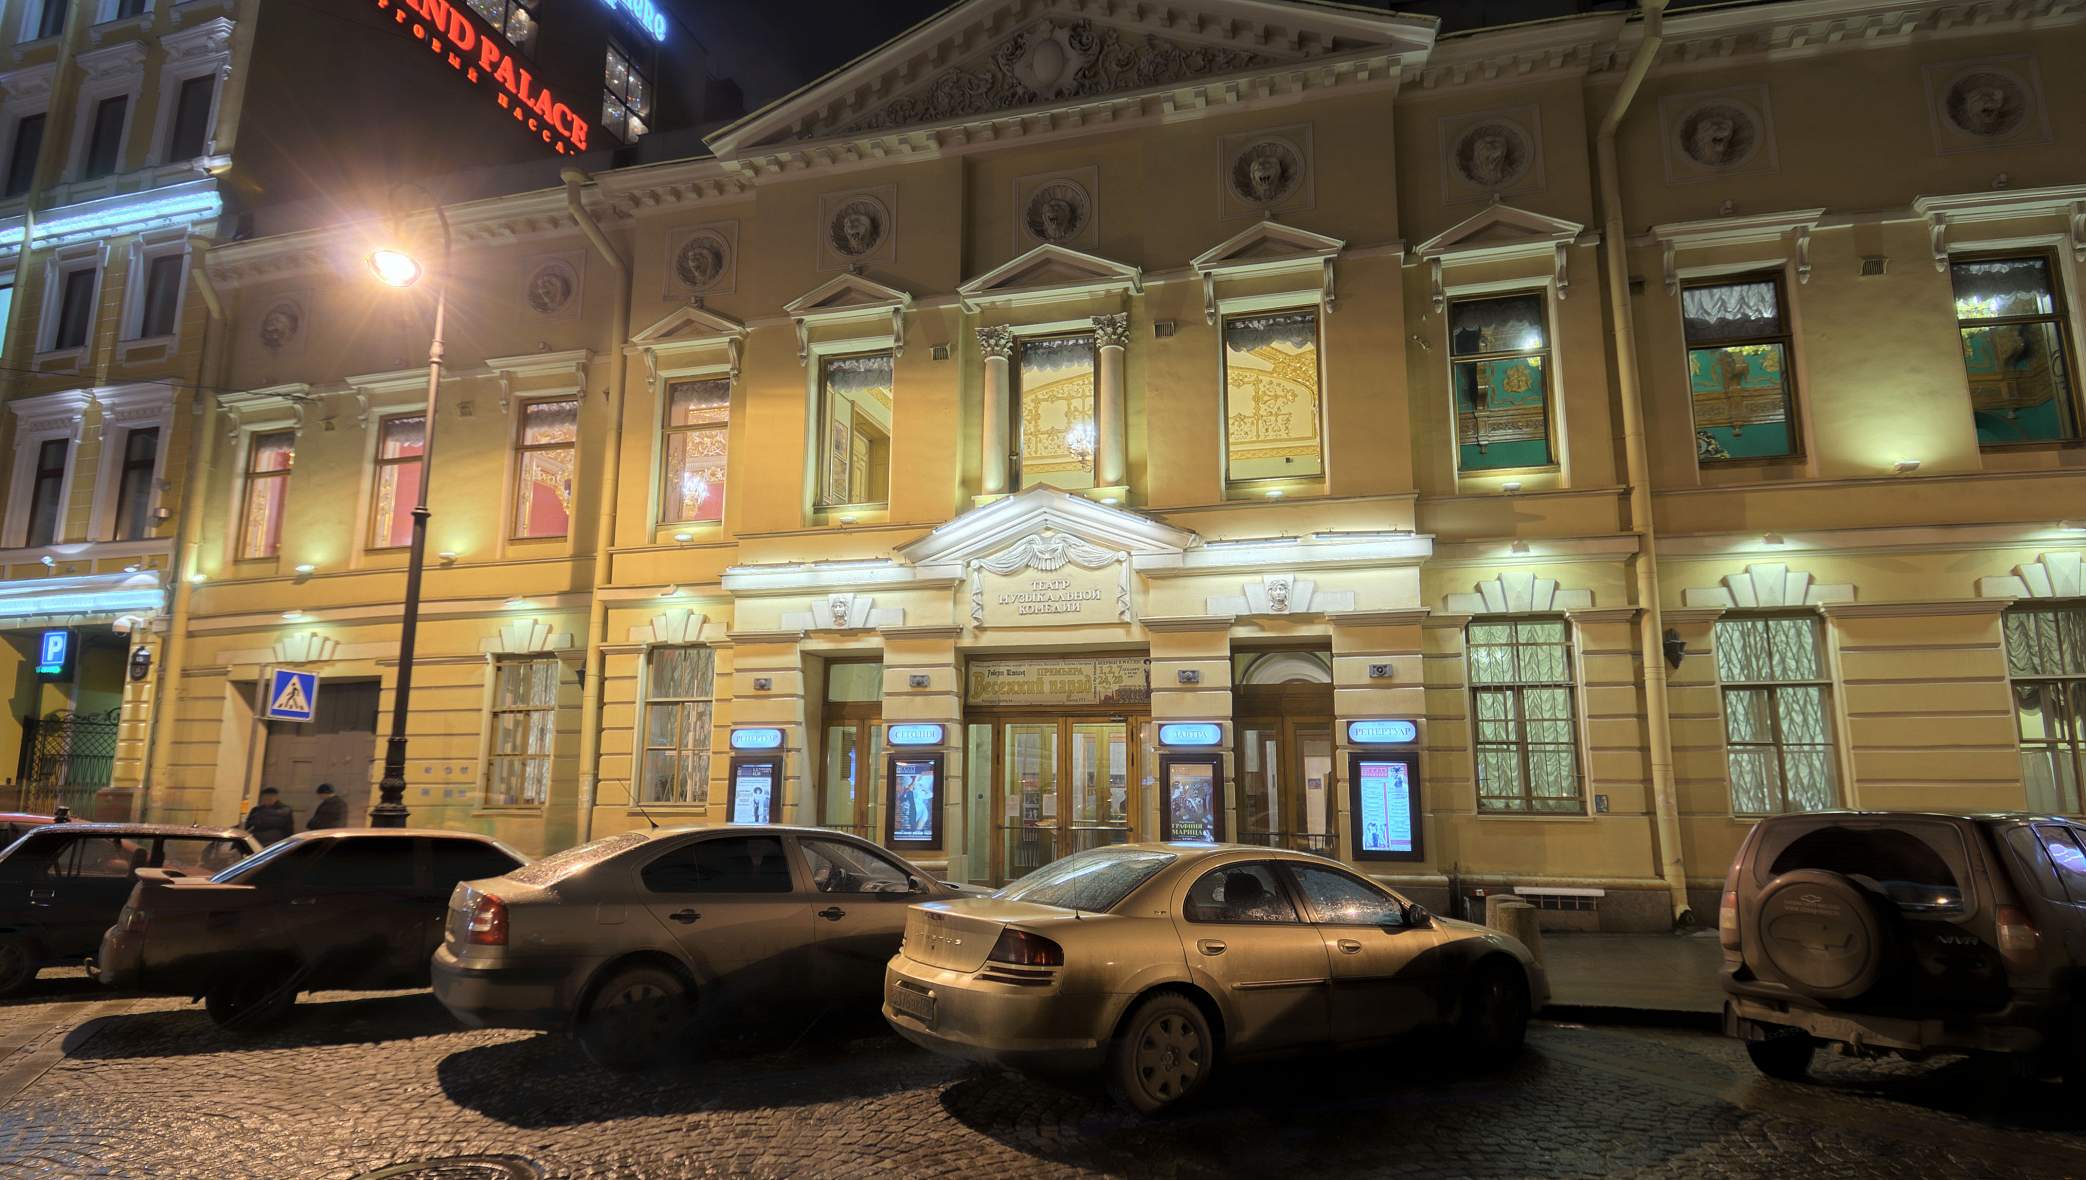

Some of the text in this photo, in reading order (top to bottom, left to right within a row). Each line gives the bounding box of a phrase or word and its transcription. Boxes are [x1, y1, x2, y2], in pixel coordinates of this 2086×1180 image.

[404, 0, 589, 151] ND PALACE
[498, 92, 575, 156] ПАССА
[1032, 580, 1071, 591] ТЕАТР
[998, 588, 1101, 605] МУЗЫКАЛЬНОЙ
[1018, 602, 1081, 615] КОМЕДИИ
[47, 636, 63, 661] P
[1355, 727, 1411, 737] РЕПЕРТУАР
